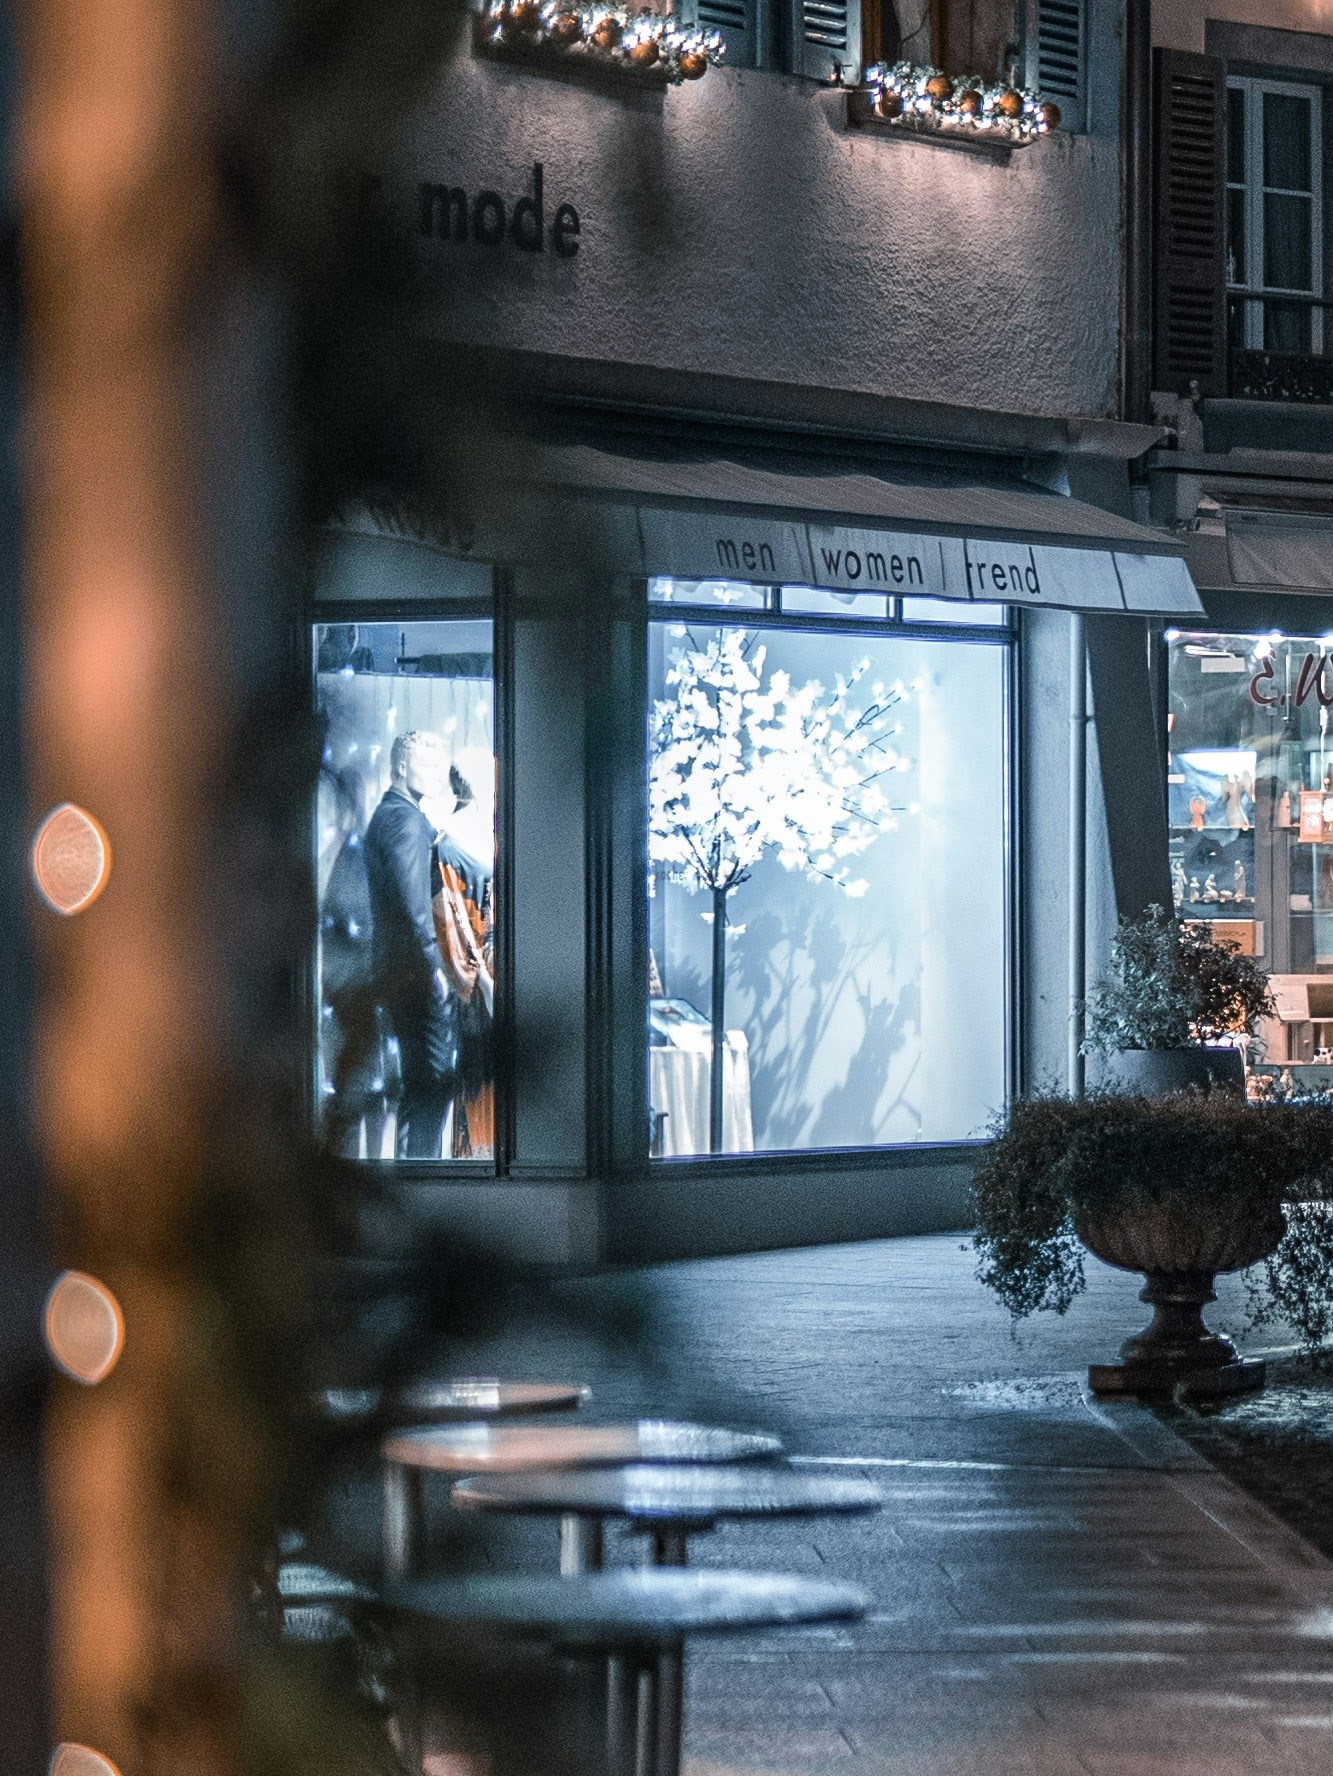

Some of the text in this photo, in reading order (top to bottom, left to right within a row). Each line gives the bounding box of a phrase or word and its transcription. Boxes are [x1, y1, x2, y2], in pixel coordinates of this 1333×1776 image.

[419, 163, 581, 259] mode
[715, 538, 1041, 595] men women trend
